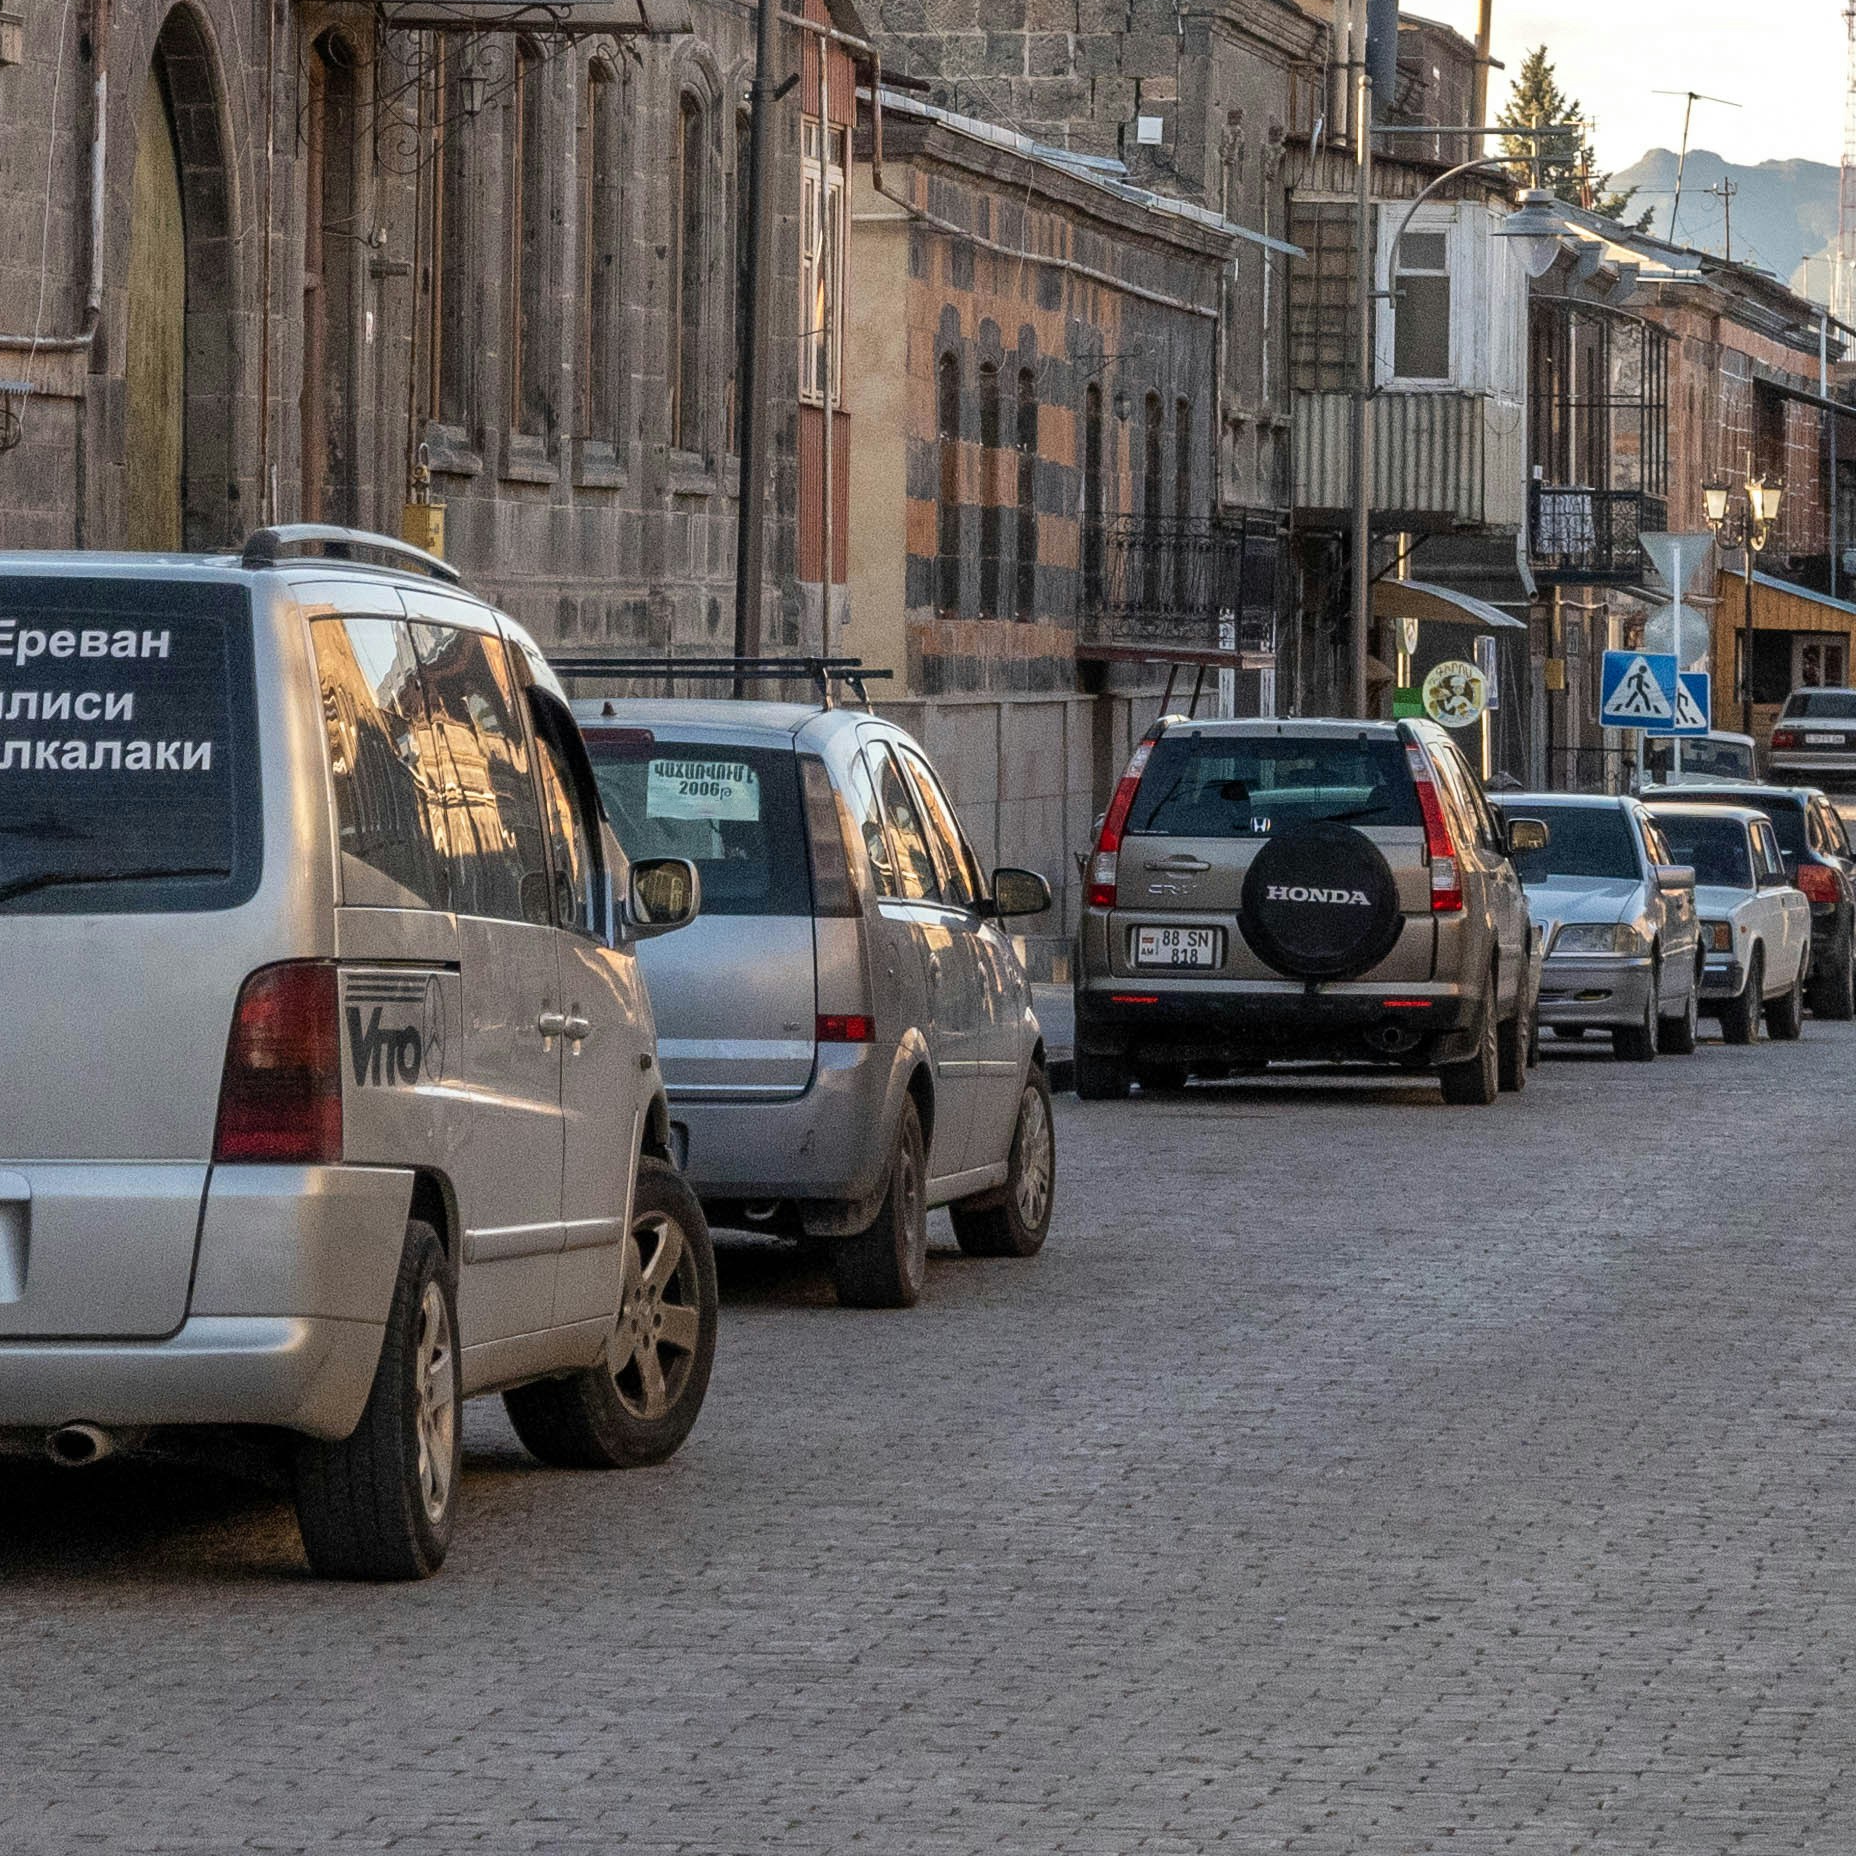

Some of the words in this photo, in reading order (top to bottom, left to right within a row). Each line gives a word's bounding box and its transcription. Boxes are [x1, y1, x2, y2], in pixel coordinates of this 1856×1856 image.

[1266, 885, 1372, 906] HONDA
[1162, 930, 1180, 947] 88
[1187, 931, 1209, 948] SN
[1171, 948, 1199, 964] 818
